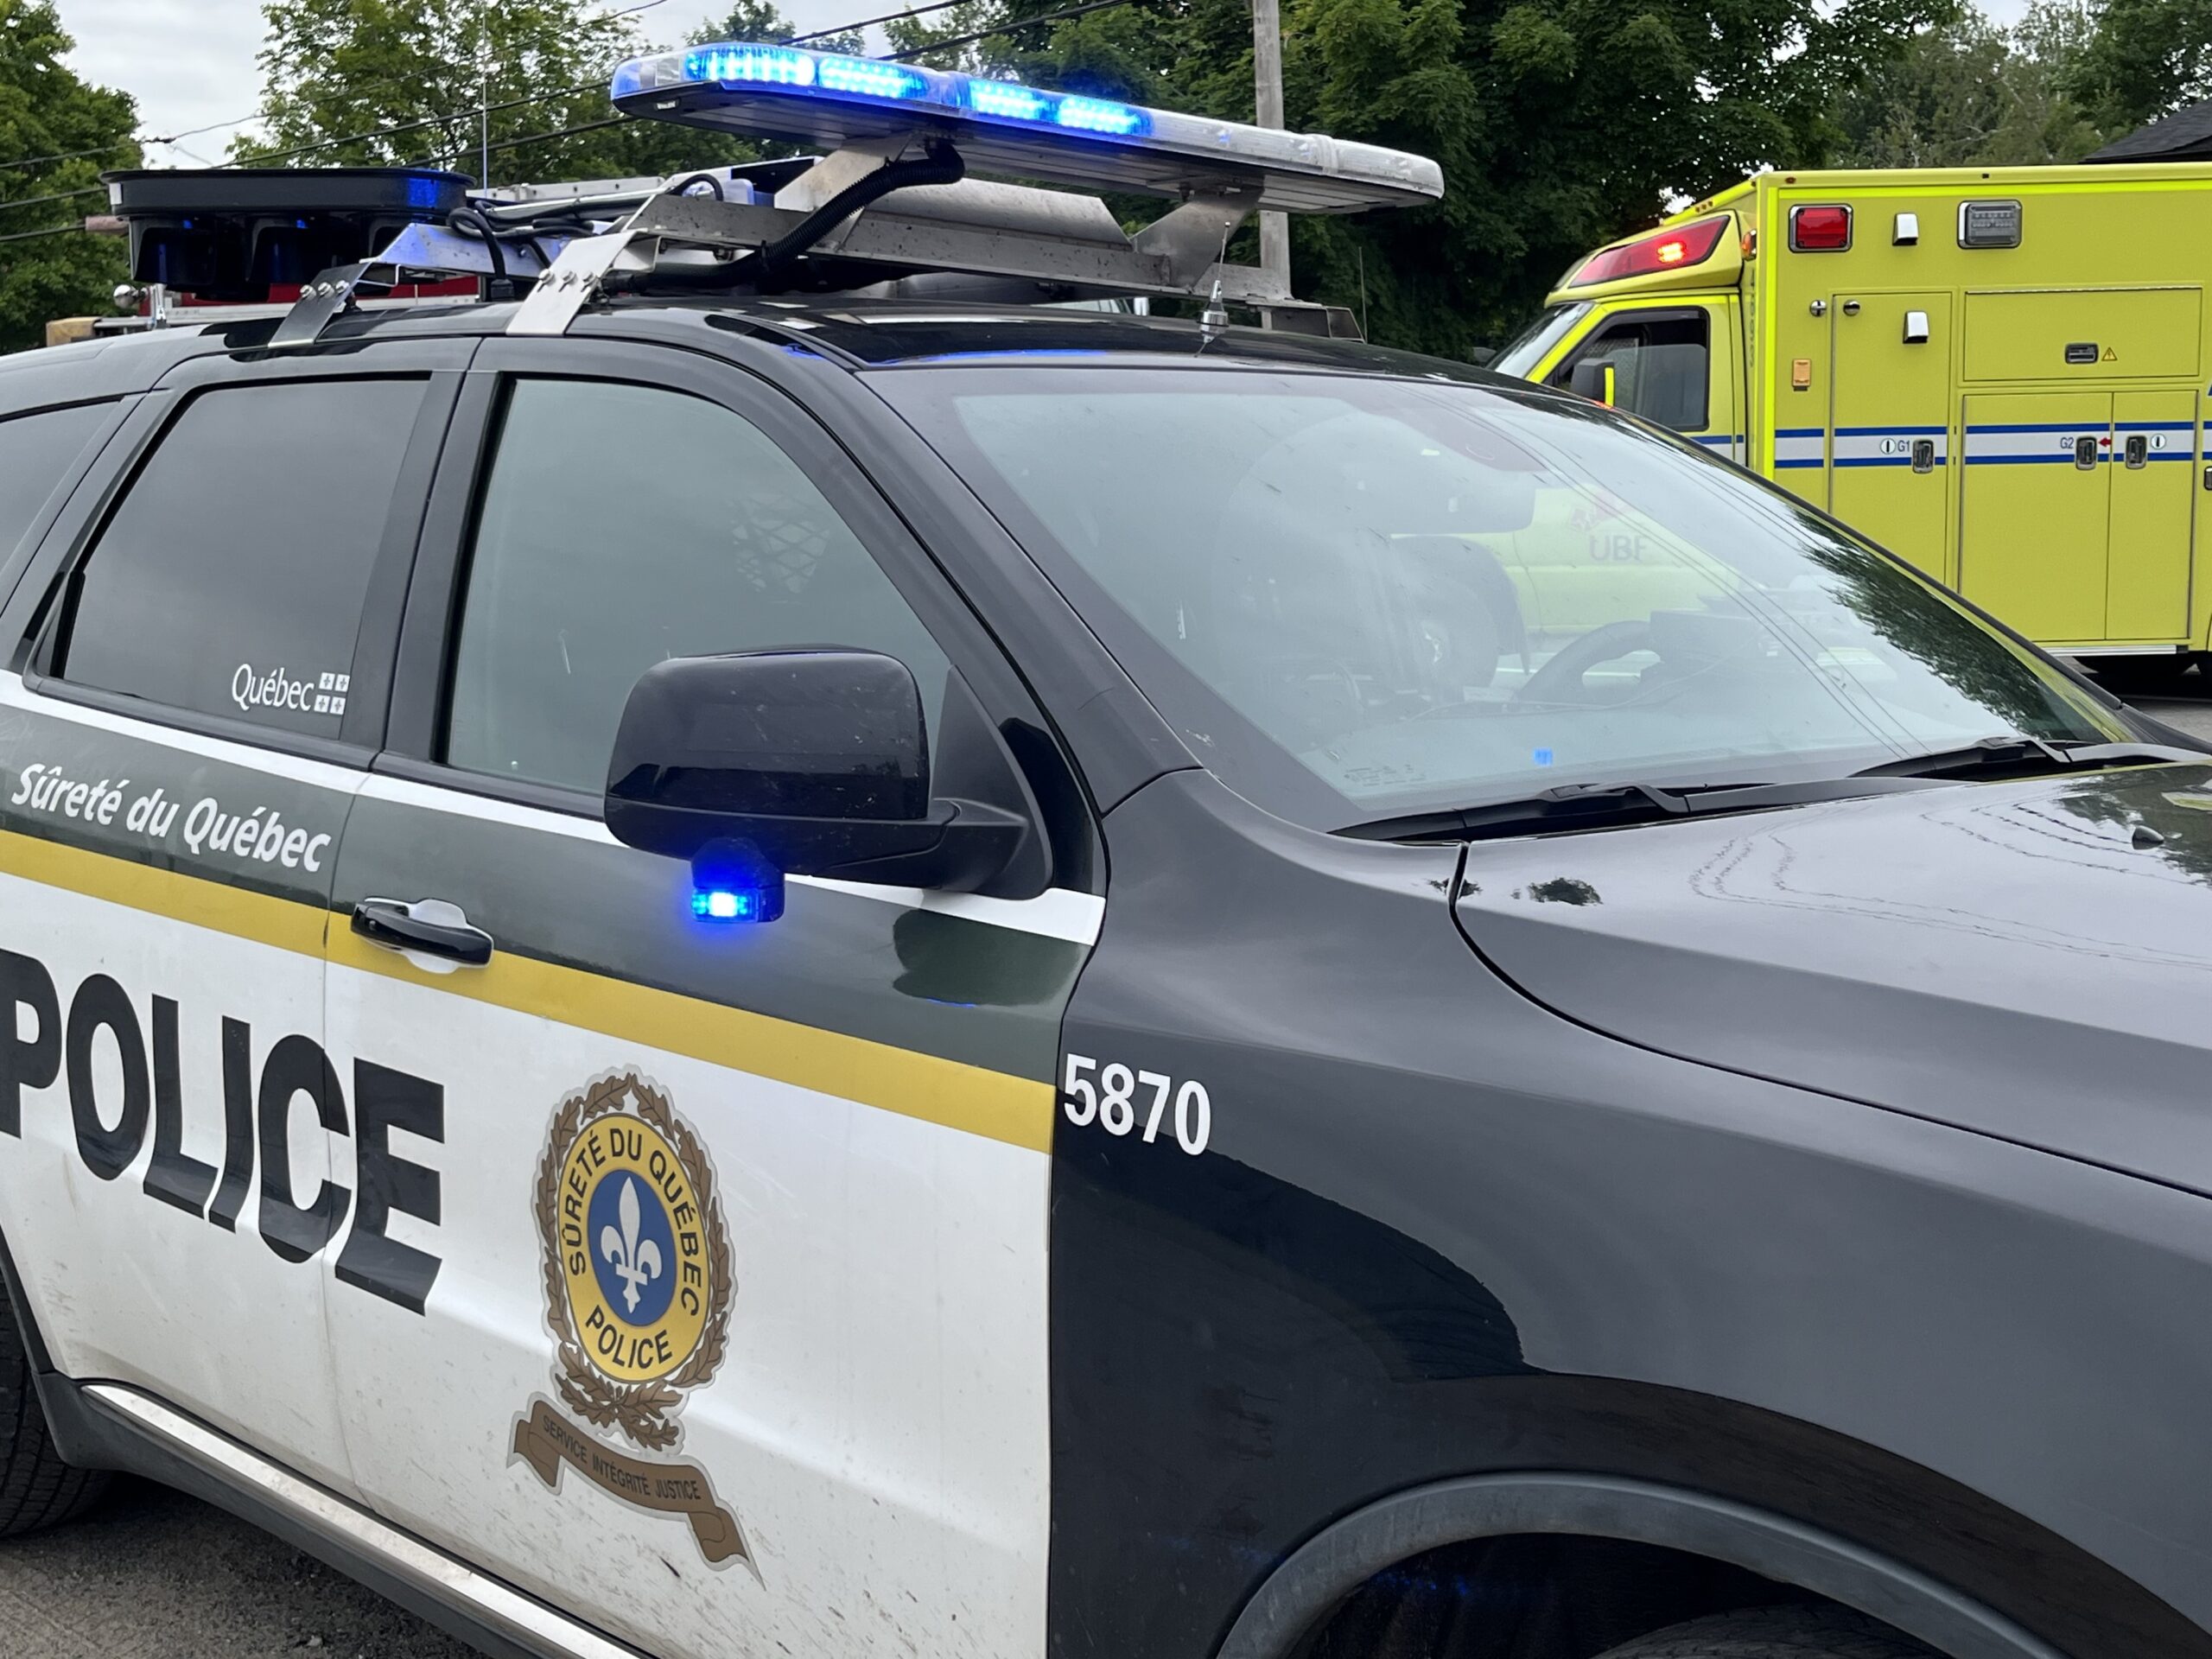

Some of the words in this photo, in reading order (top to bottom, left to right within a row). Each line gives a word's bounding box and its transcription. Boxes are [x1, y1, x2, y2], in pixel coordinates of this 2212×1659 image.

[1897, 440, 1910, 452] G1
[2060, 436, 2075, 449] G2
[231, 663, 315, 711] Québec
[10, 763, 130, 826] Sûreté
[125, 788, 181, 838] du
[183, 798, 332, 873] Québec
[0, 949, 445, 1317] POLICE
[1064, 1052, 1211, 1156] 5870
[561, 1128, 607, 1277] SÛRETÉ
[609, 1127, 643, 1162] DU
[649, 1149, 703, 1318] QUÉBEC
[585, 1304, 673, 1370] POLICE
[542, 1414, 588, 1465] SERVICE
[592, 1453, 652, 1497] INTÉGRITÉ
[655, 1478, 702, 1500] JUSTICE
